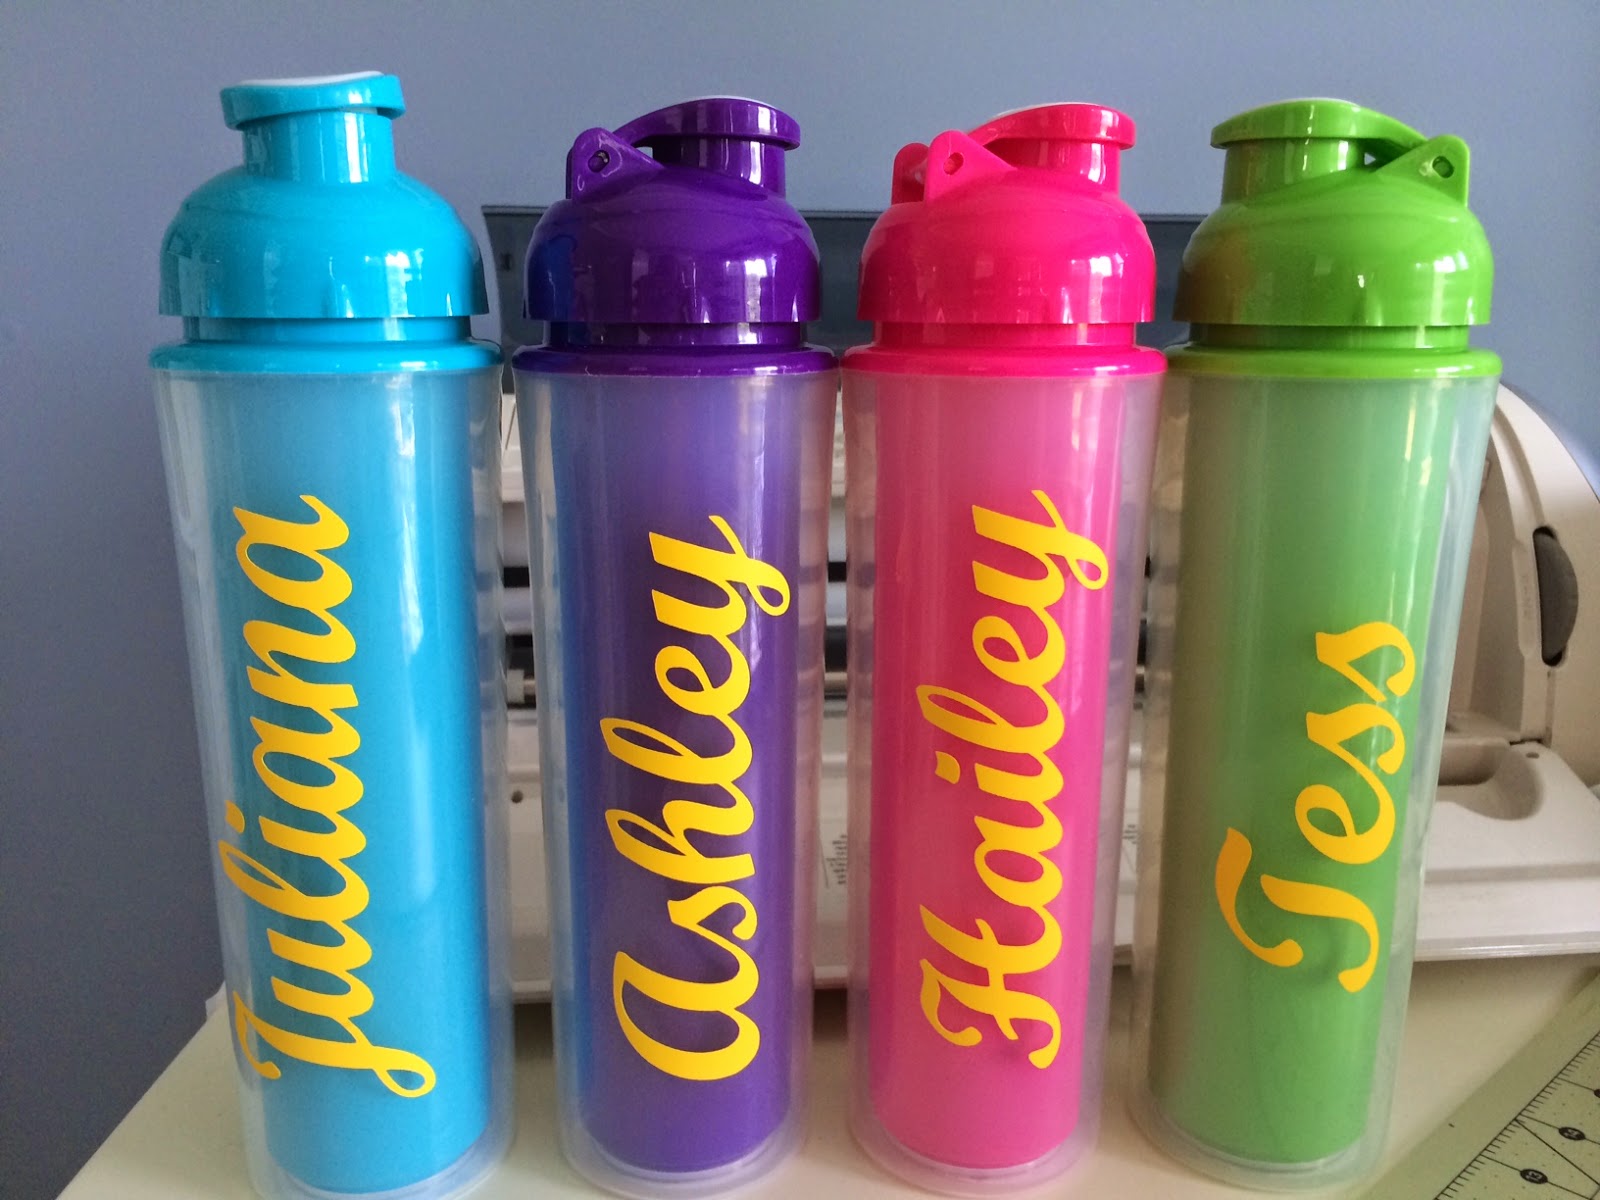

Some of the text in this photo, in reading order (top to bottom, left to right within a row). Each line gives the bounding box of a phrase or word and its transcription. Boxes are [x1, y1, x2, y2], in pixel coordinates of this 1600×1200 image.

[219, 495, 436, 1097] Juliana
[601, 515, 792, 1081] Ashley
[918, 489, 1109, 1069] Hailey
[1216, 621, 1416, 993] Tess
